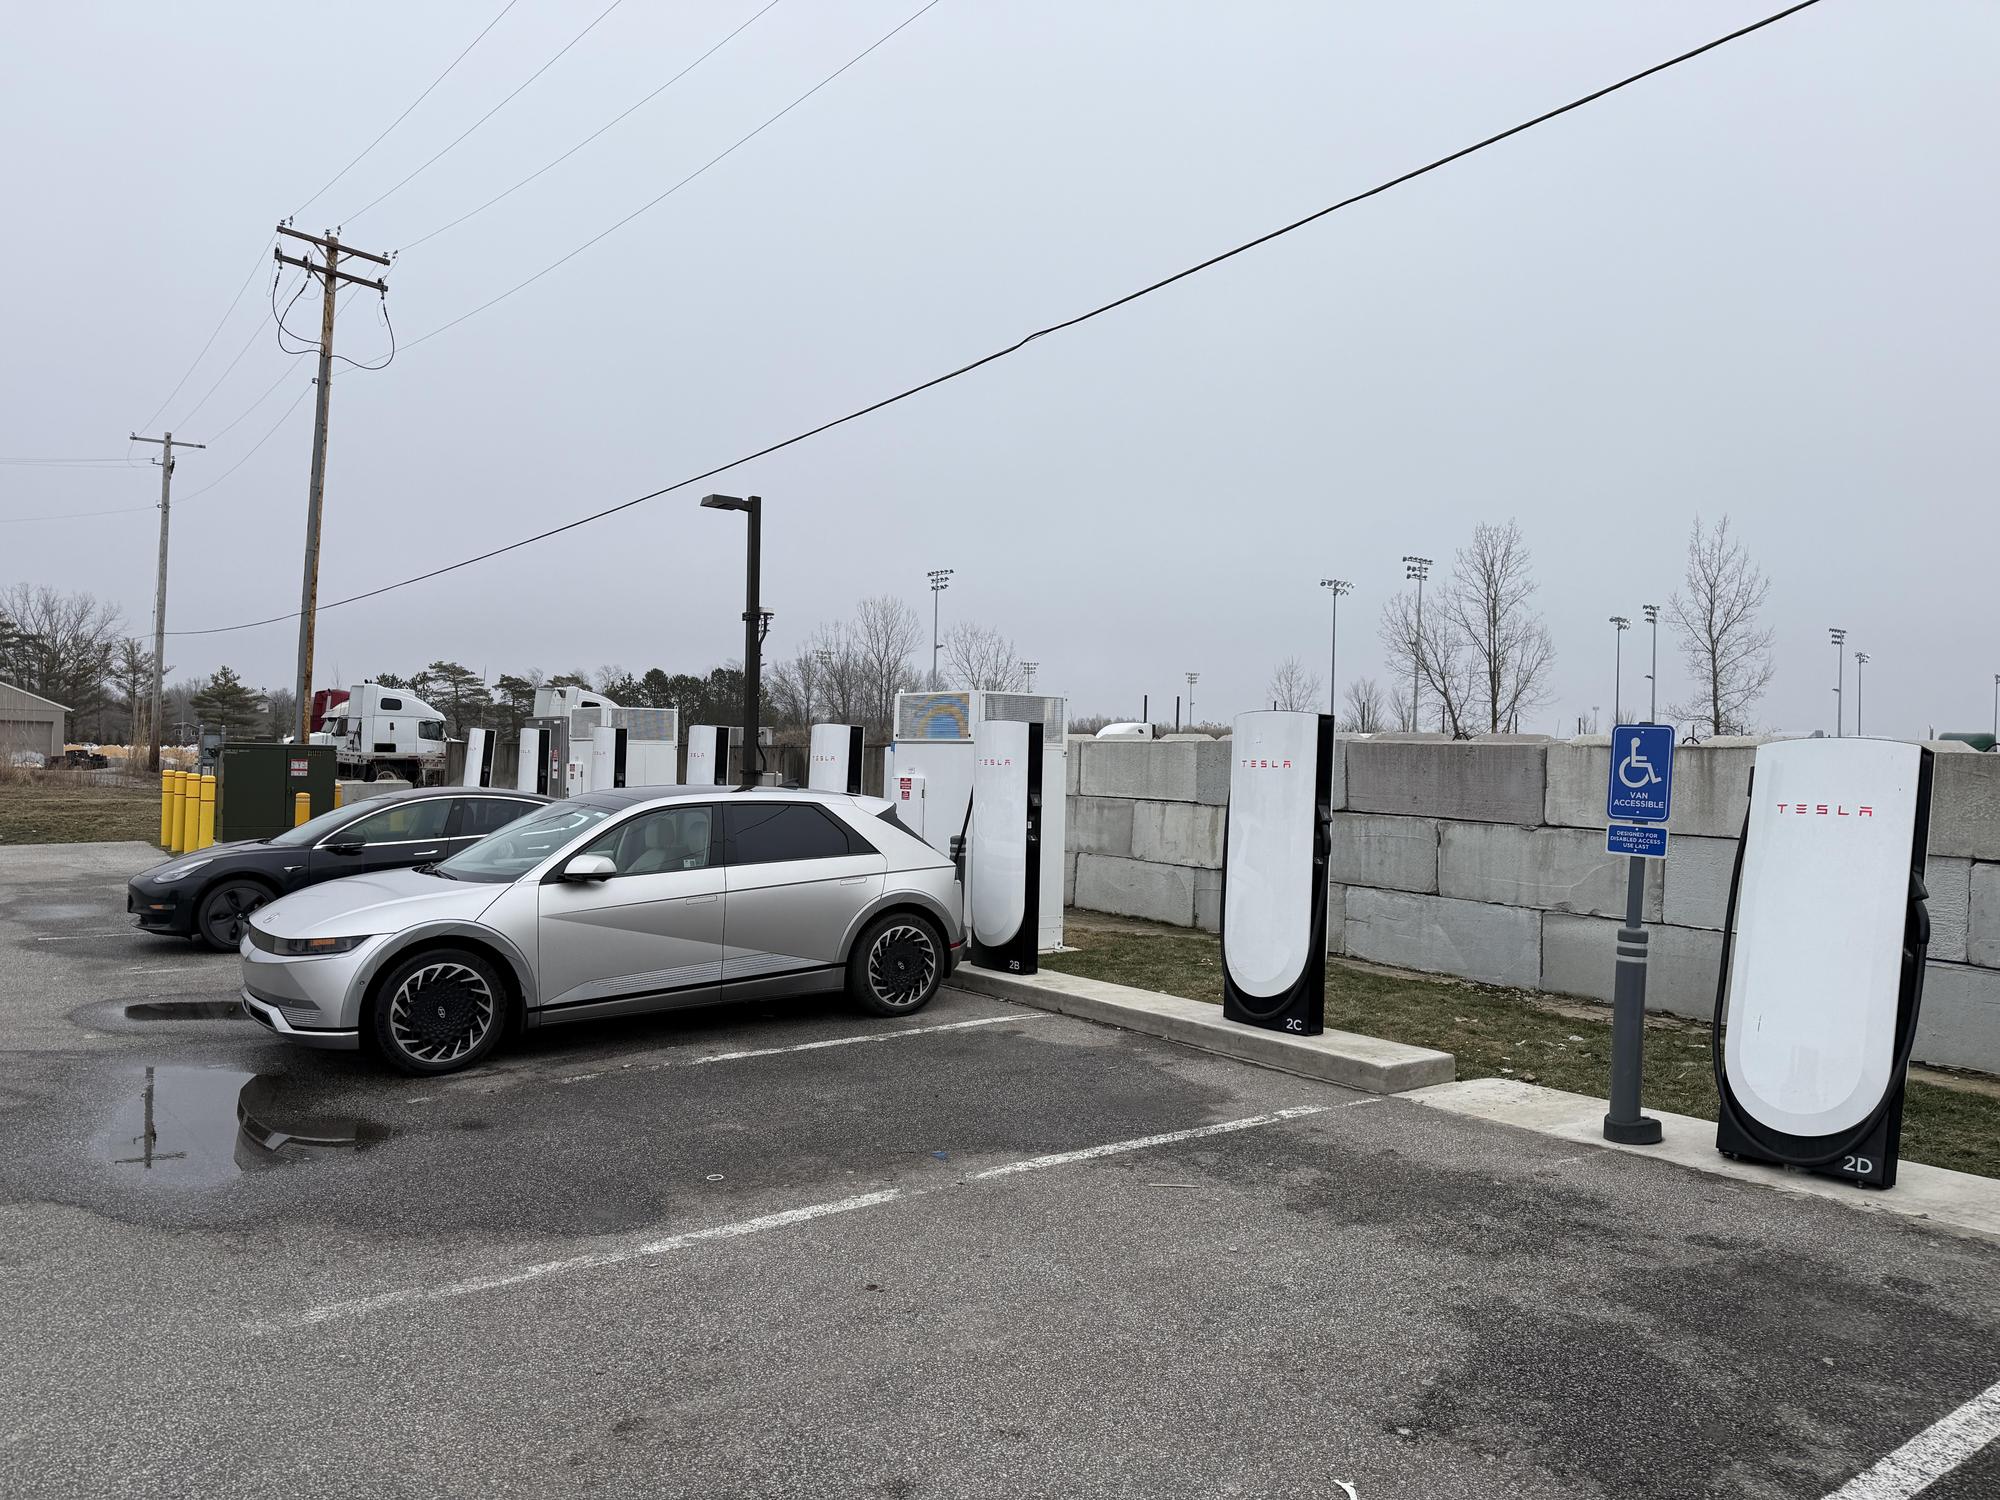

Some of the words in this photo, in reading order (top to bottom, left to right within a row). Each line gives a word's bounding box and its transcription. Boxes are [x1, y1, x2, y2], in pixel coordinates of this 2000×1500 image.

[1241, 760, 1291, 768] TESLA
[1630, 791, 1648, 799] VAN
[1613, 799, 1664, 808] ACCESSIBLE
[1777, 804, 1873, 817] TESLA
[1009, 960, 1020, 970] 2B
[1286, 1018, 1302, 1031] 2C
[1842, 1155, 1873, 1174] 2D
